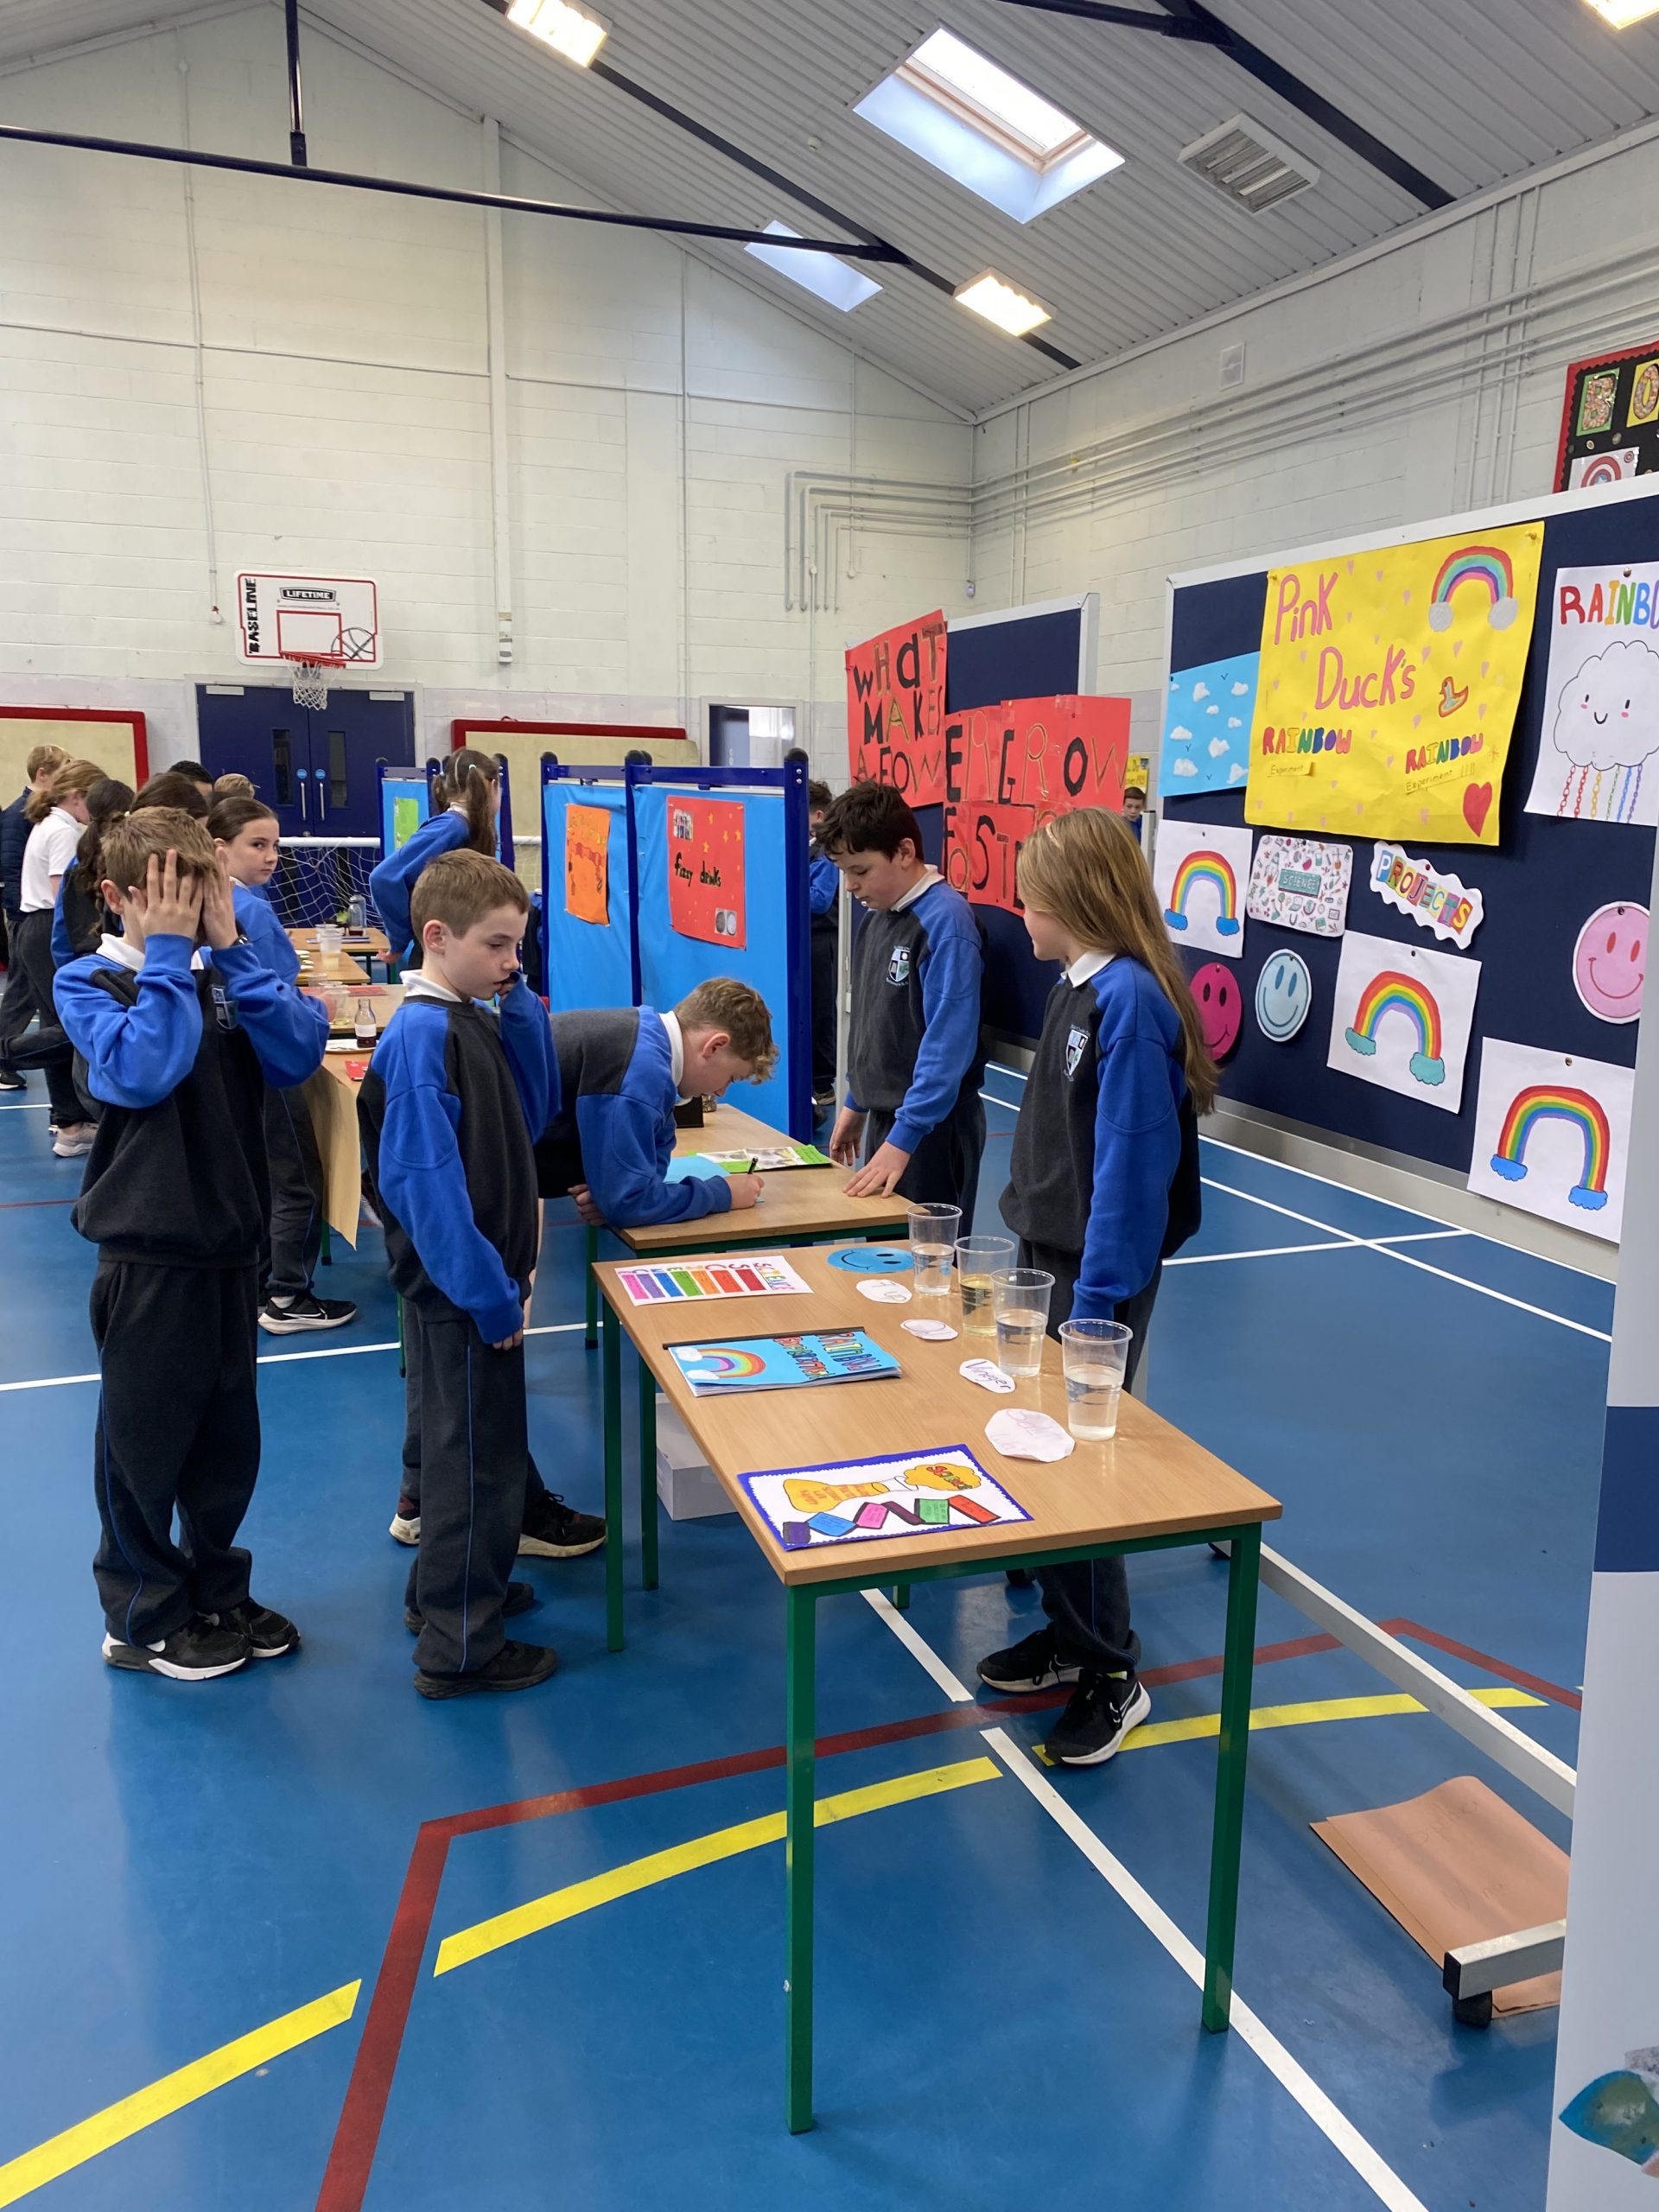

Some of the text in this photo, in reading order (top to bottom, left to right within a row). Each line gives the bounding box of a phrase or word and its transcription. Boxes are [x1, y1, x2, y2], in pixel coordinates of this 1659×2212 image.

[286, 590, 330, 599] LIFETIME
[245, 577, 261, 654] BASELINE
[1262, 727, 1352, 755] RAINBOW
[1406, 733, 1484, 774] RAINBOW
[998, 723, 1129, 804] GROW
[1270, 764, 1305, 775] Experiment
[1406, 770, 1453, 791] Experiment
[1282, 873, 1319, 891] SCIENCE
[1377, 851, 1473, 933] PROJECTS
